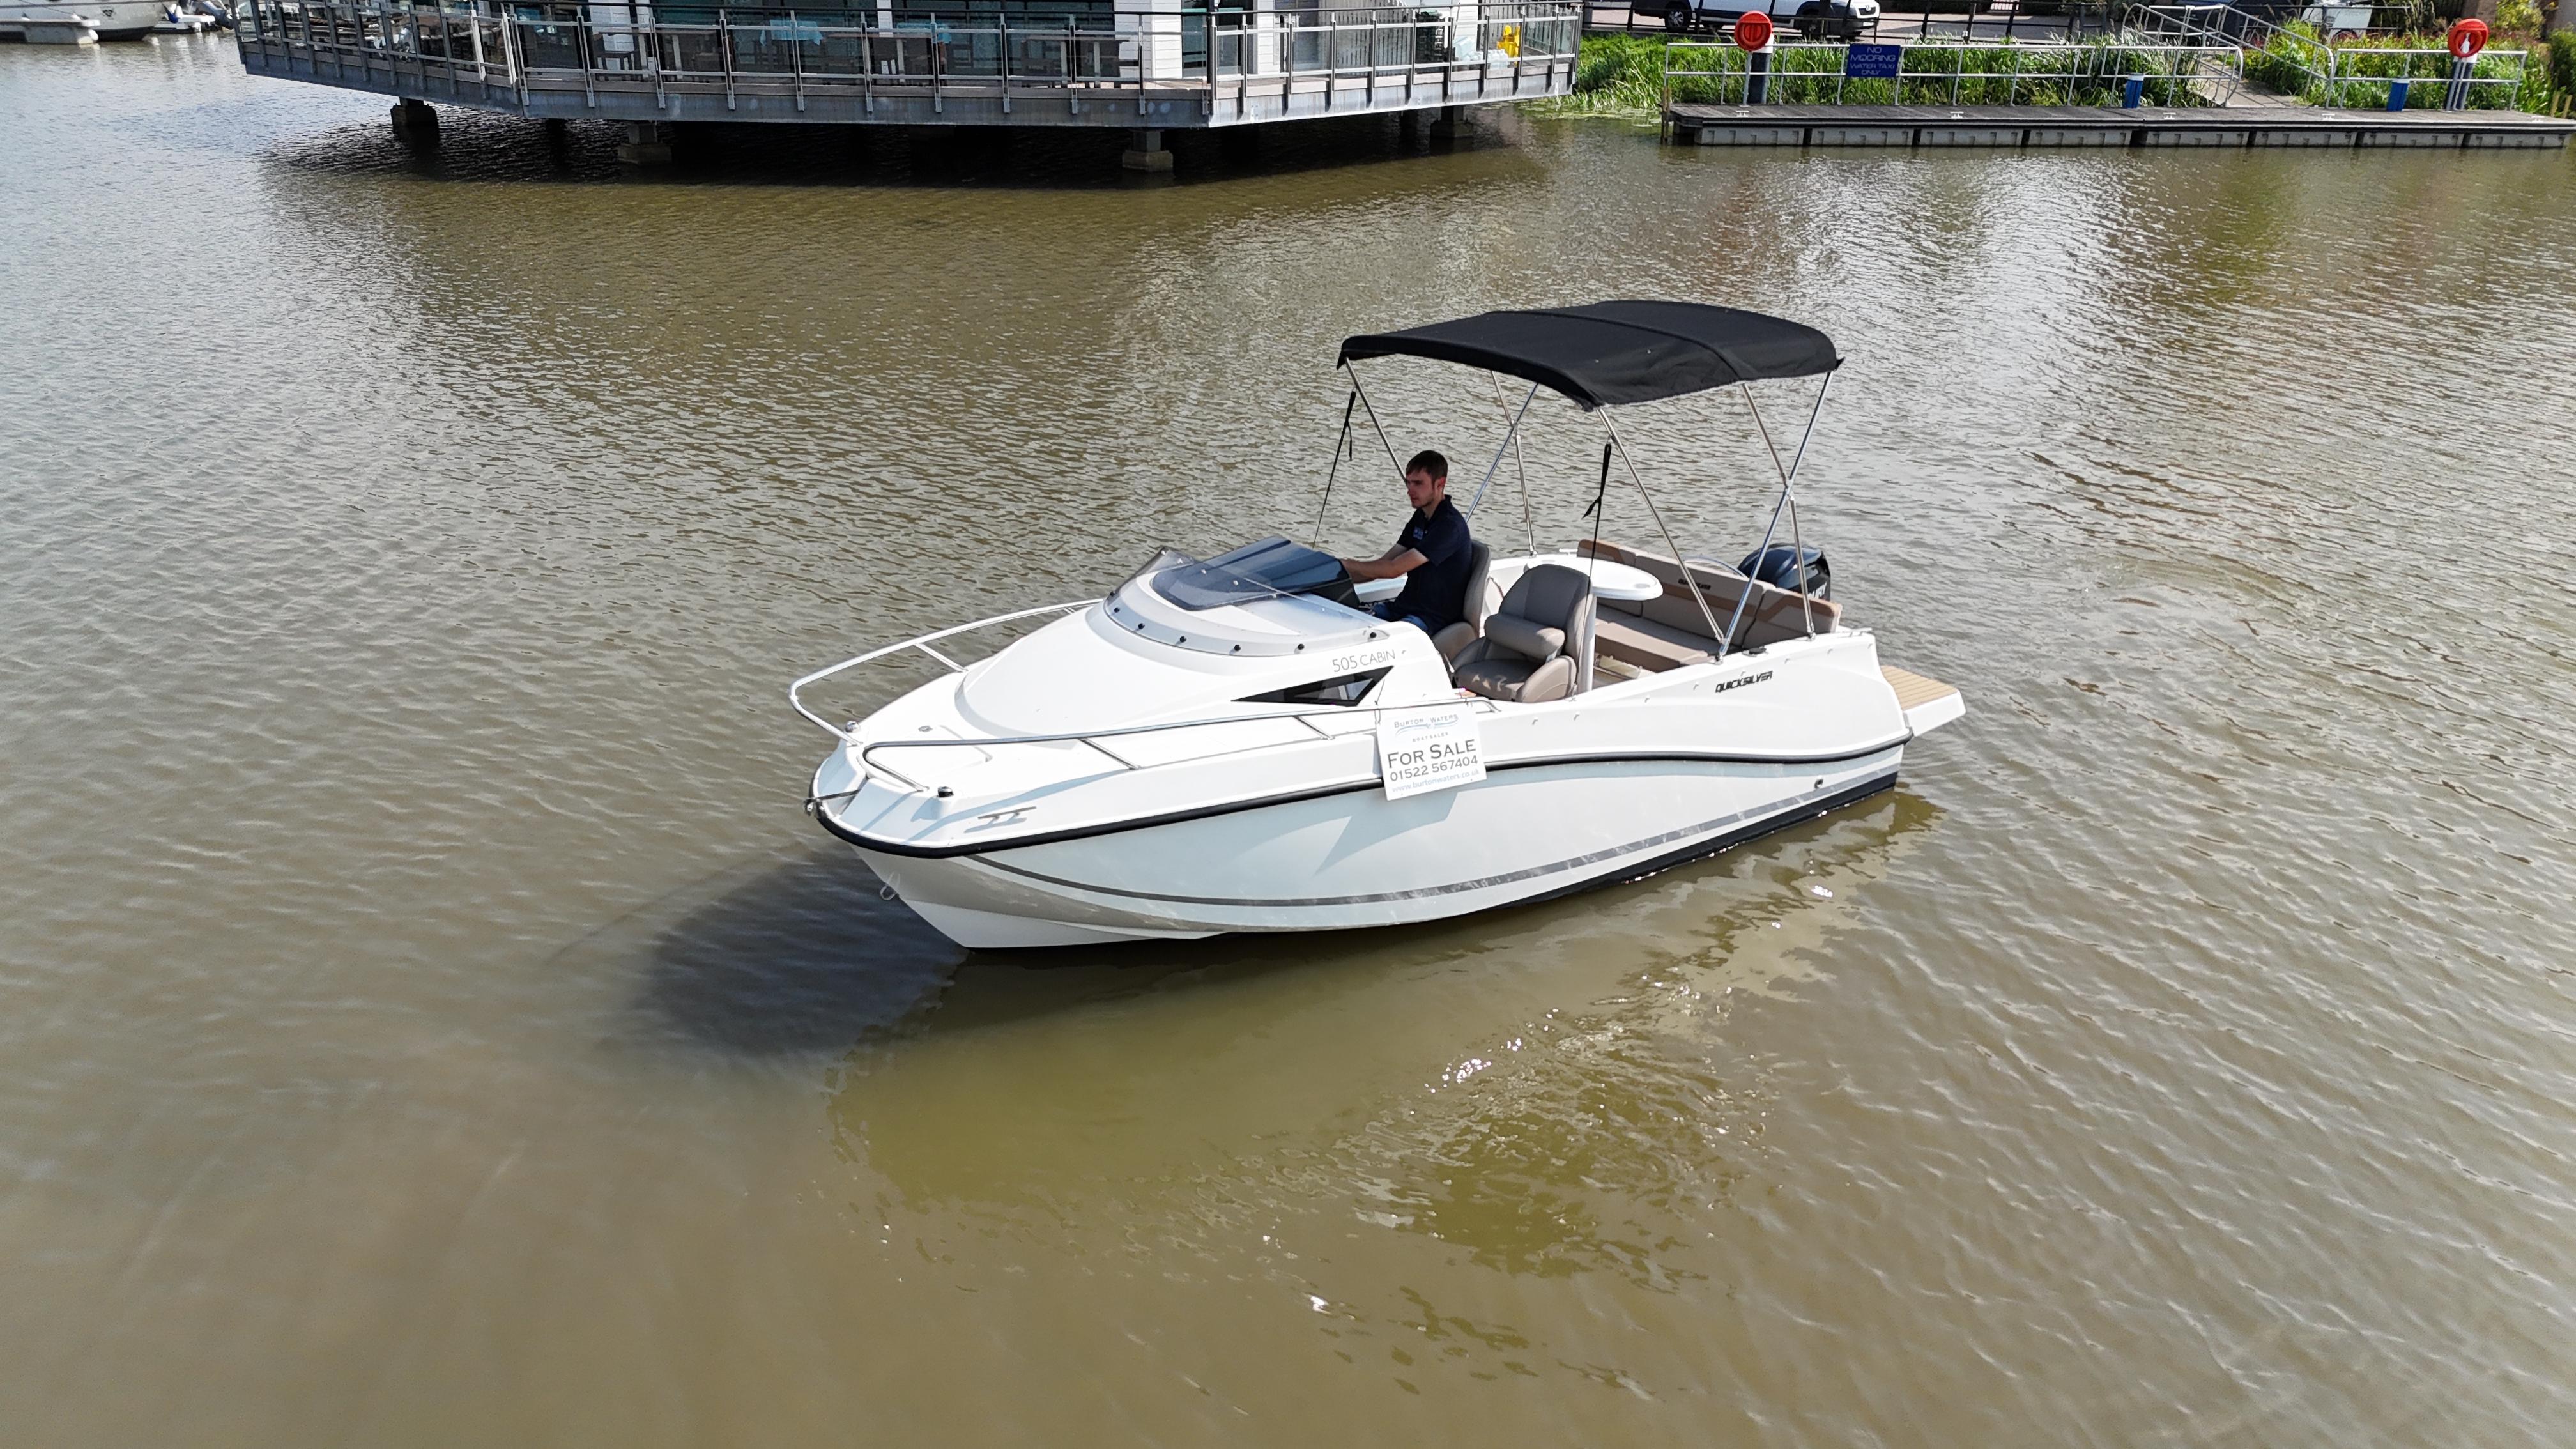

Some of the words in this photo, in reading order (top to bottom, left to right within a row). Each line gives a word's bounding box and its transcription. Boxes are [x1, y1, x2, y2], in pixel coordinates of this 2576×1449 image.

[1332, 656, 1358, 673] 505
[1360, 649, 1396, 666] CABIN
[1715, 670, 1773, 693] QUICKSILVER
[1393, 718, 1424, 728] BURTON
[1430, 714, 1458, 723] WATERS
[1429, 731, 1448, 739] SALES
[1387, 750, 1425, 769] FOR
[1430, 739, 1476, 760] SALE
[1390, 765, 1429, 781] 01522
[1431, 755, 1478, 773] 567404
[1392, 769, 1480, 792] www.burtonwaters.co.uk
